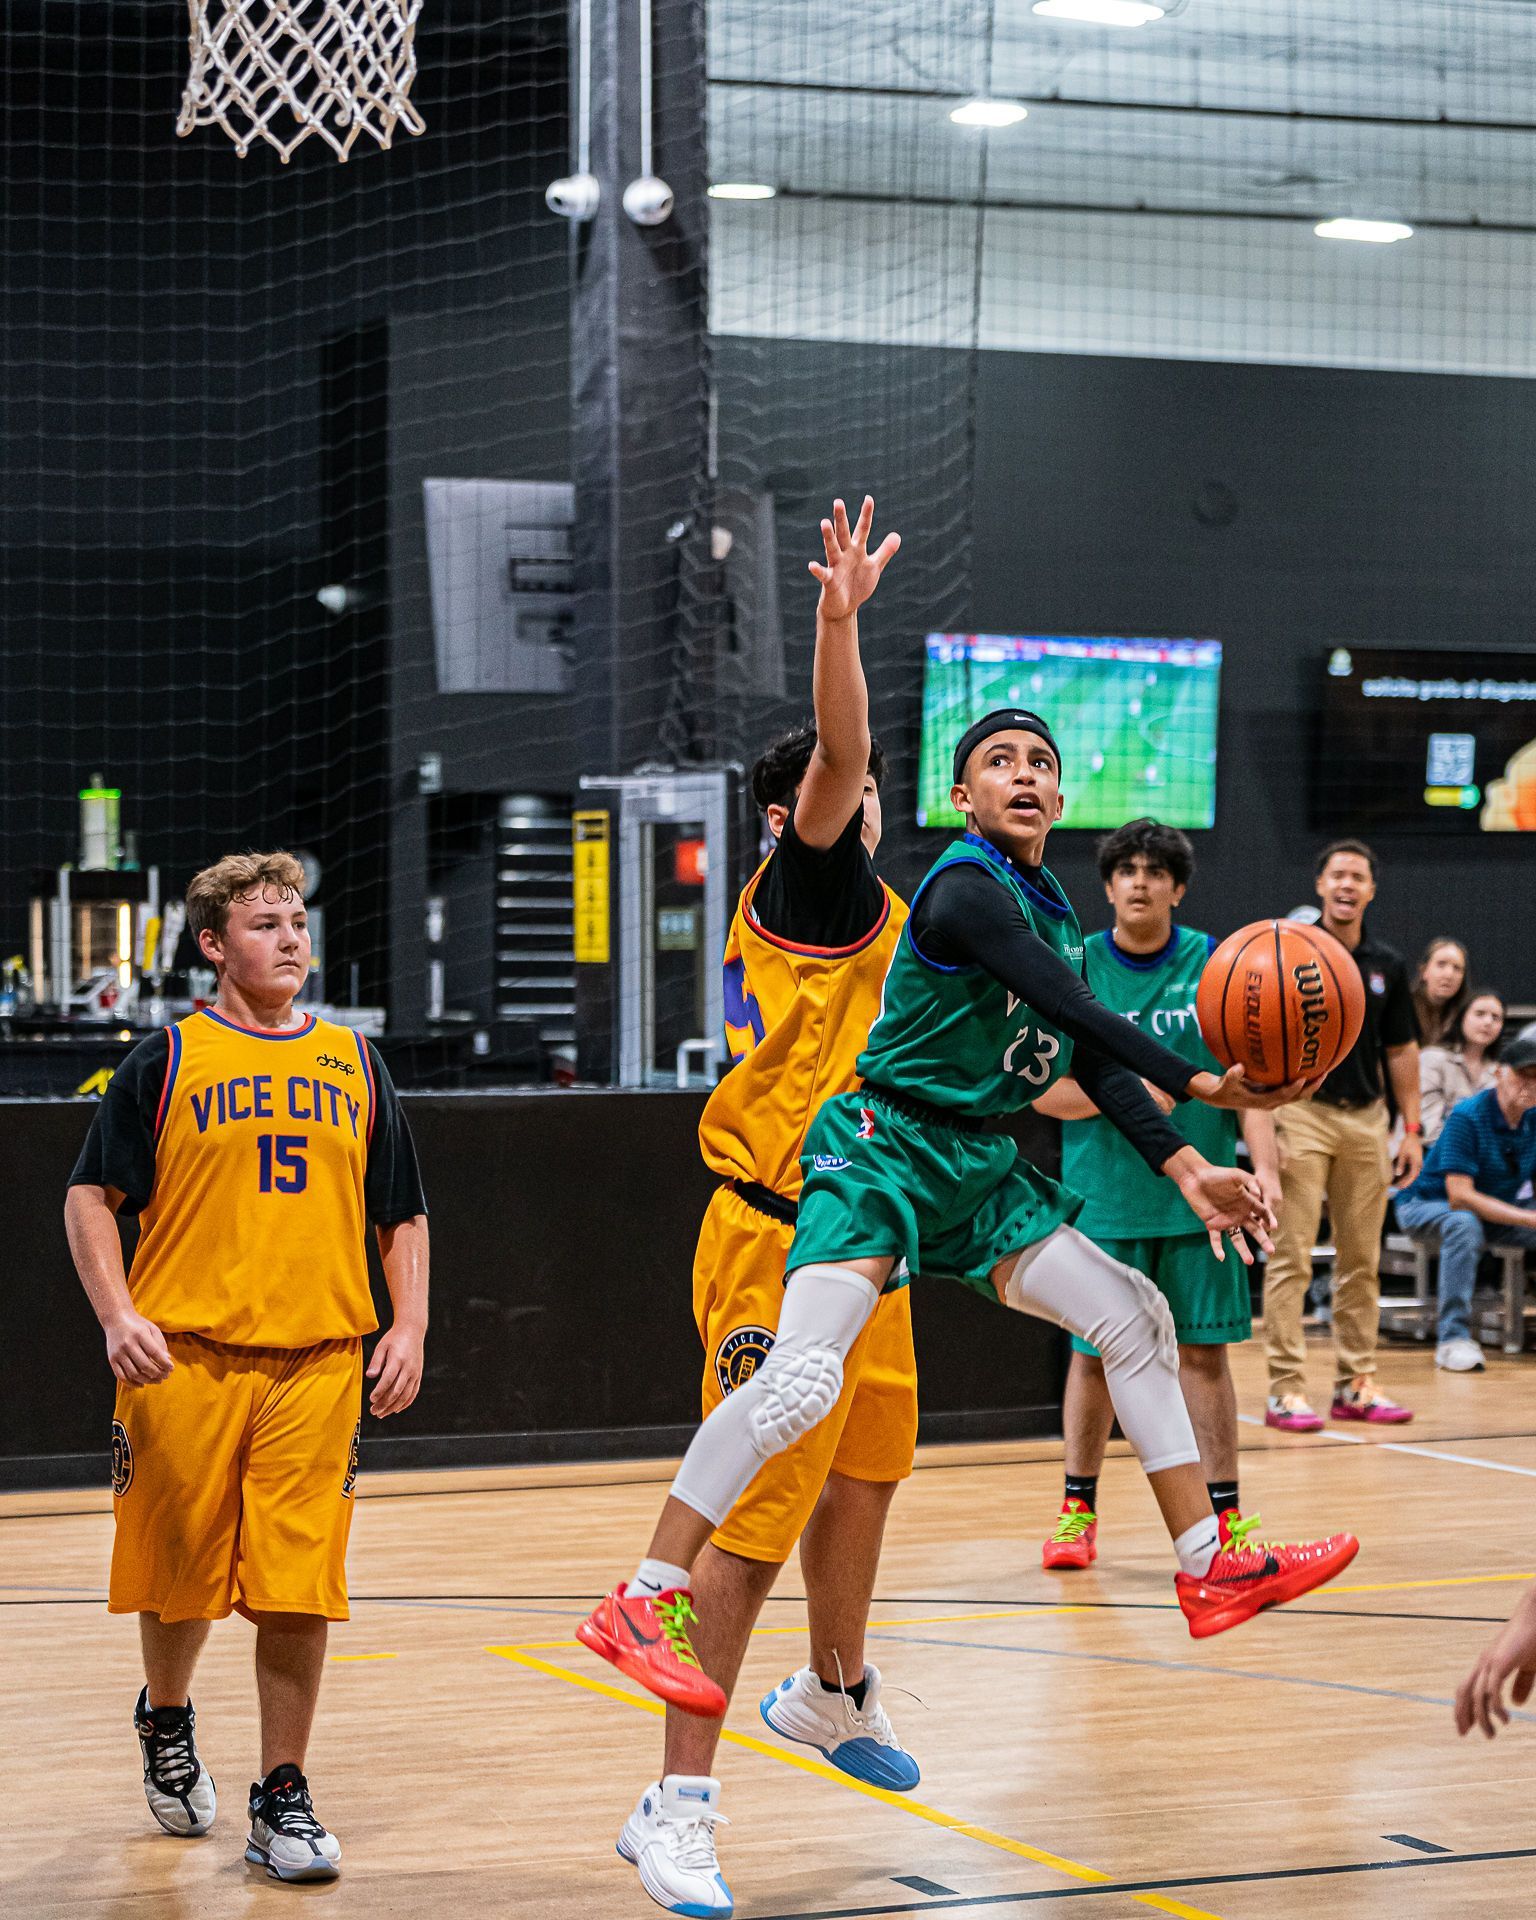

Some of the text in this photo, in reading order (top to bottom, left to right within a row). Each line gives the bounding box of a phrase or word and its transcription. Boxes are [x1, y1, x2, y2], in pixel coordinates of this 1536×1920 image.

[1293, 960, 1329, 1073] Wilson
[190, 1075, 361, 1140] VICE CITY
[257, 1134, 309, 1194] 15
[728, 1333, 754, 1351] VICE
